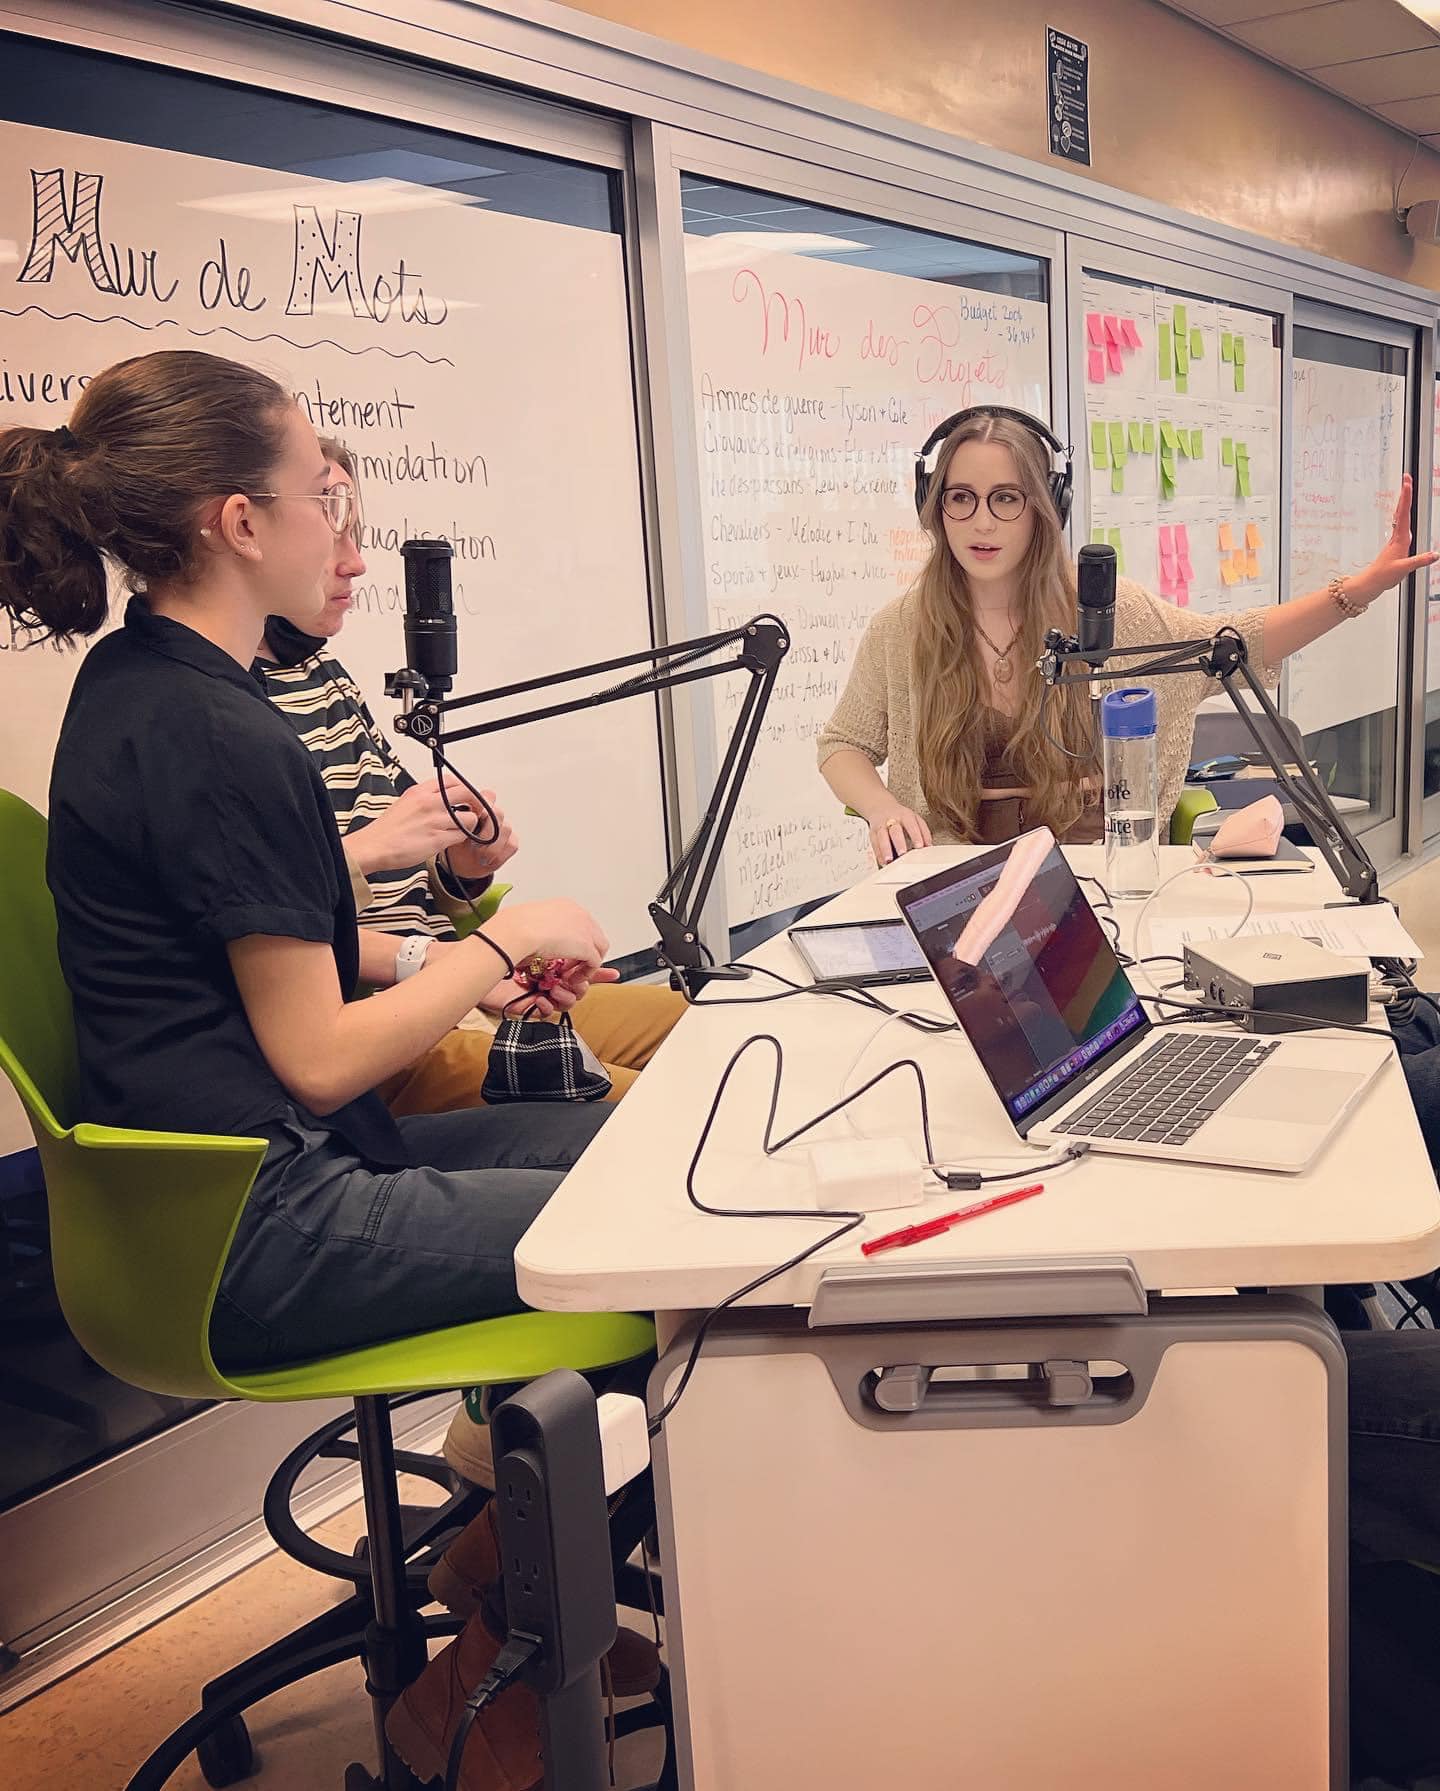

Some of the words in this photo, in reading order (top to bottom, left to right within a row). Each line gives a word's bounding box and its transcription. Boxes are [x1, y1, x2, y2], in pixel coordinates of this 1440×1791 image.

[17, 168, 179, 302] Mur
[200, 238, 267, 312] de
[285, 204, 448, 326] Mots
[732, 269, 841, 373] Mur
[861, 319, 911, 367] des
[959, 296, 998, 332] Budget
[293, 378, 415, 430] ntement
[700, 372, 758, 413] Armes
[761, 387, 780, 414] de
[783, 396, 826, 434] guerre
[835, 386, 877, 435] Tyson
[354, 441, 488, 487] midation
